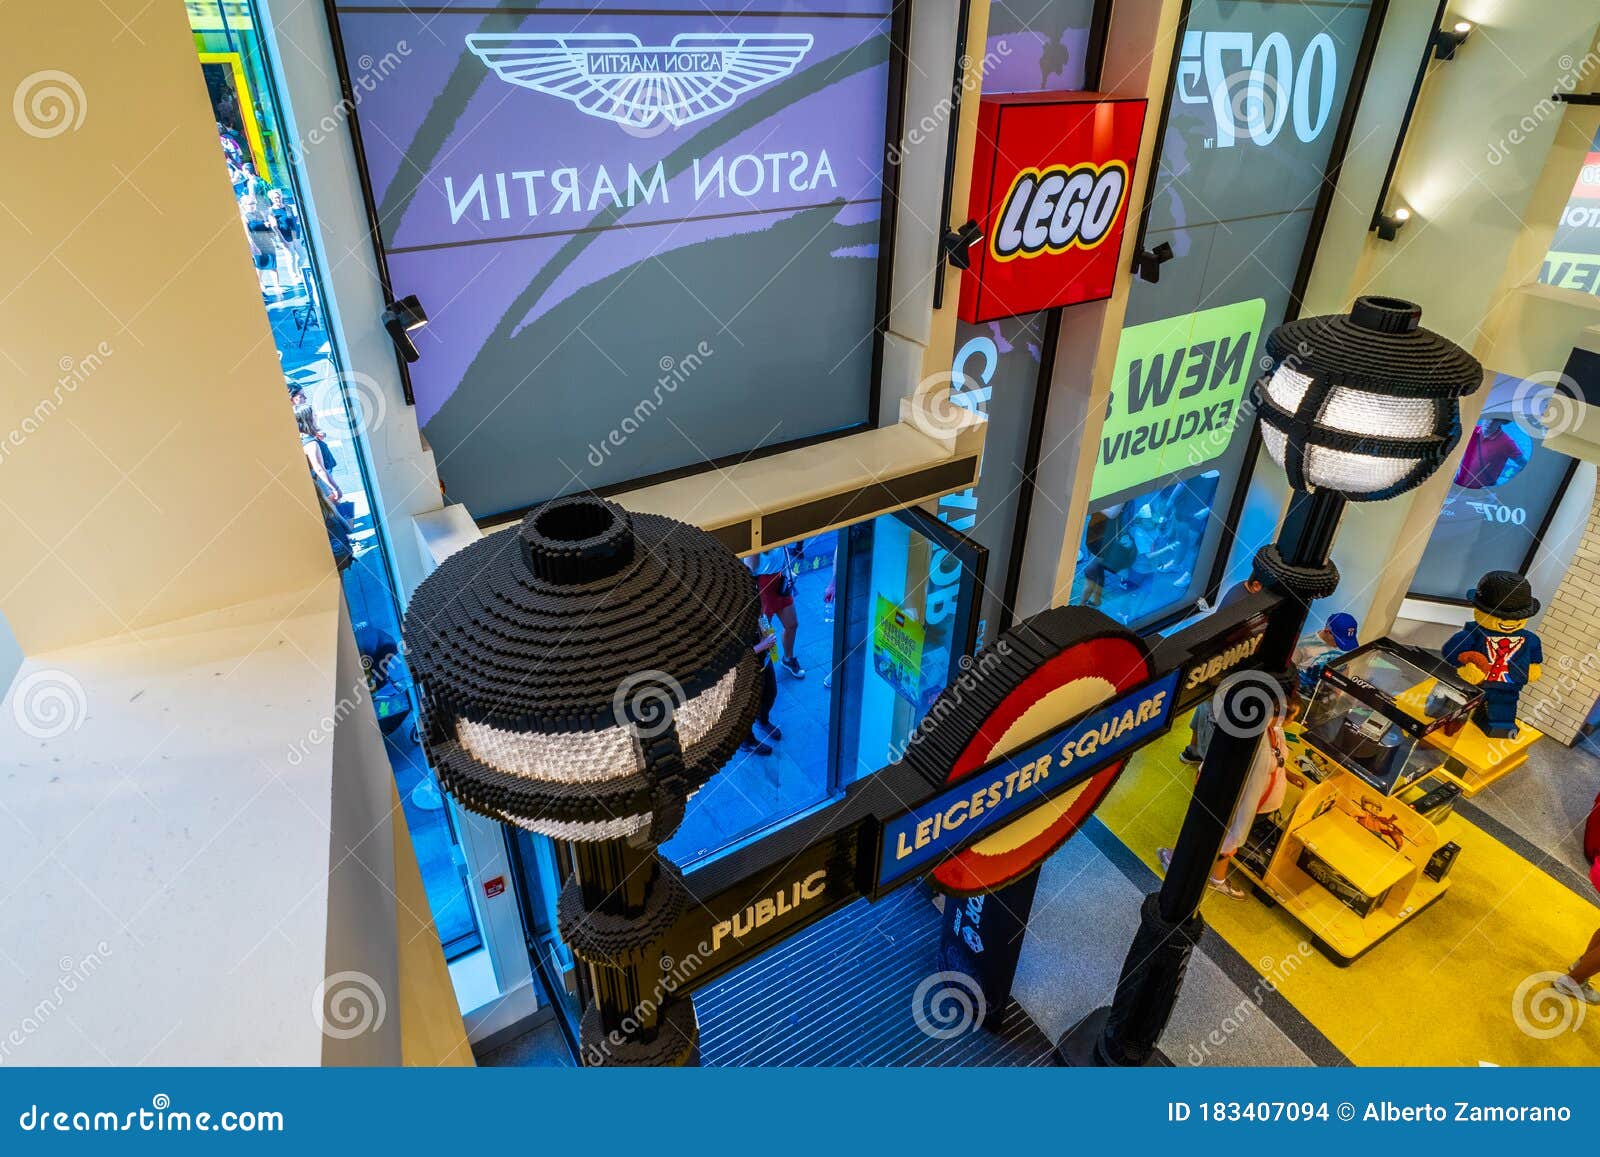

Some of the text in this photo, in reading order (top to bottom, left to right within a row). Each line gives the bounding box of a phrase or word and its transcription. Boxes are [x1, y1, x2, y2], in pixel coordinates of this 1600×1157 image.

[997, 170, 1123, 253] LEGO
[1185, 633, 1264, 690] SUBWAY
[896, 690, 1167, 860] LEICESTER SQUARE
[711, 869, 827, 952] PUBLIC
